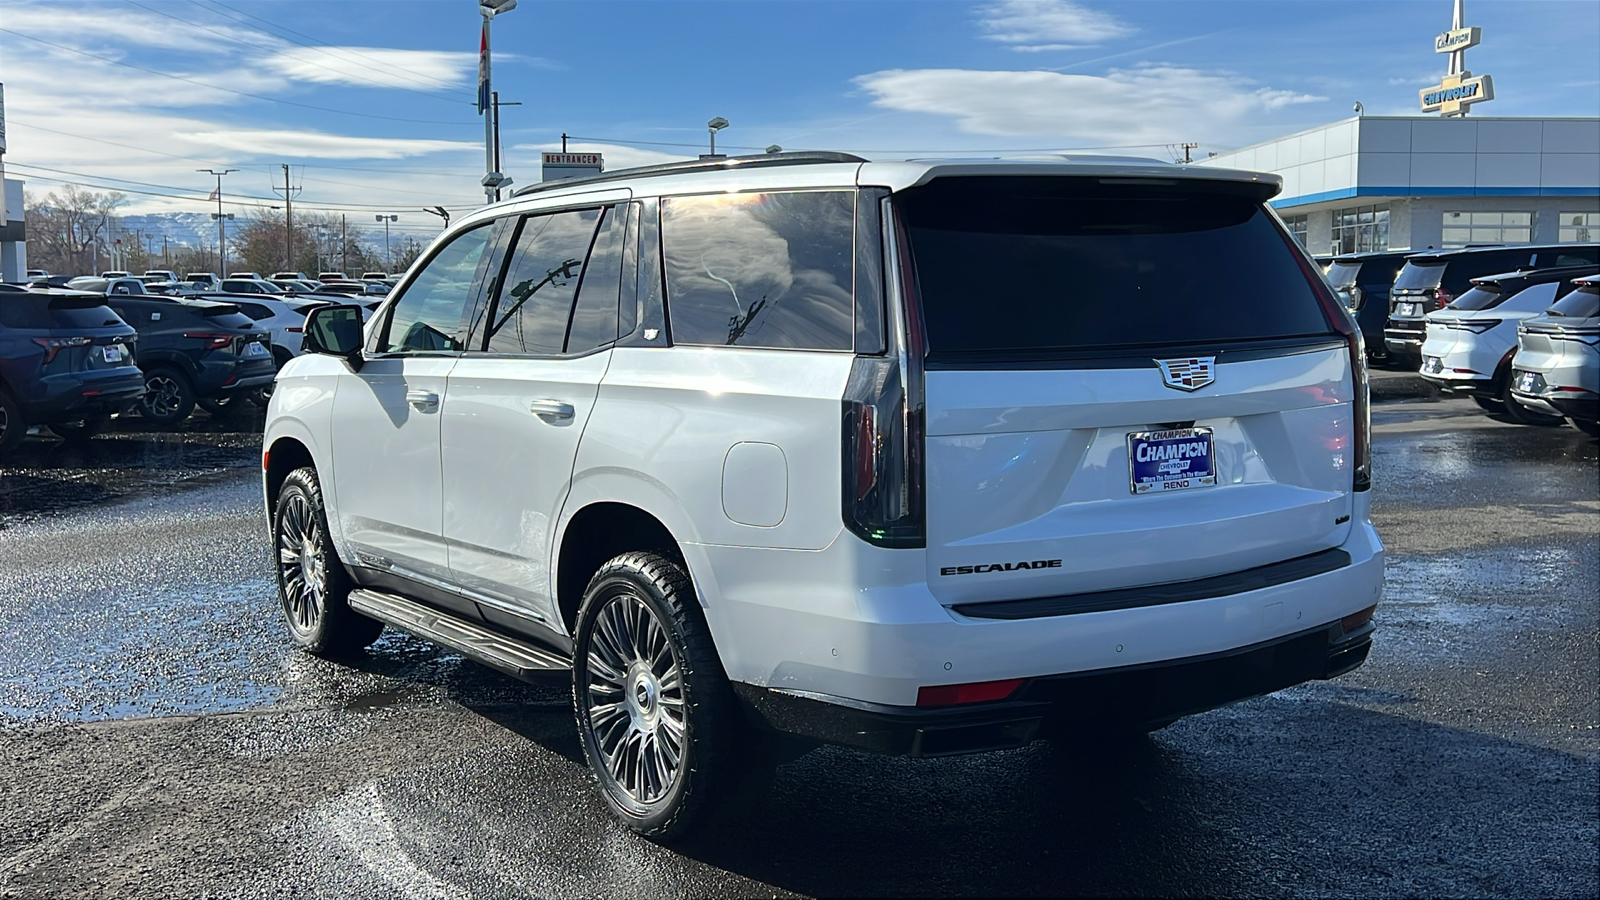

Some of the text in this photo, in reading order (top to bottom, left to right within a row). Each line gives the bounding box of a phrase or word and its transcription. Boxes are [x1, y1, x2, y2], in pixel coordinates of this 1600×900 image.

[1423, 82, 1478, 105] CHEVROLET
[551, 155, 592, 164] ENTRANCE
[1153, 430, 1192, 440] CHAMPION
[1137, 442, 1207, 462] CHAMPION
[1160, 461, 1188, 470] CHEVROLET
[1163, 480, 1190, 490] RENO
[940, 559, 1063, 576] ESCALADE
